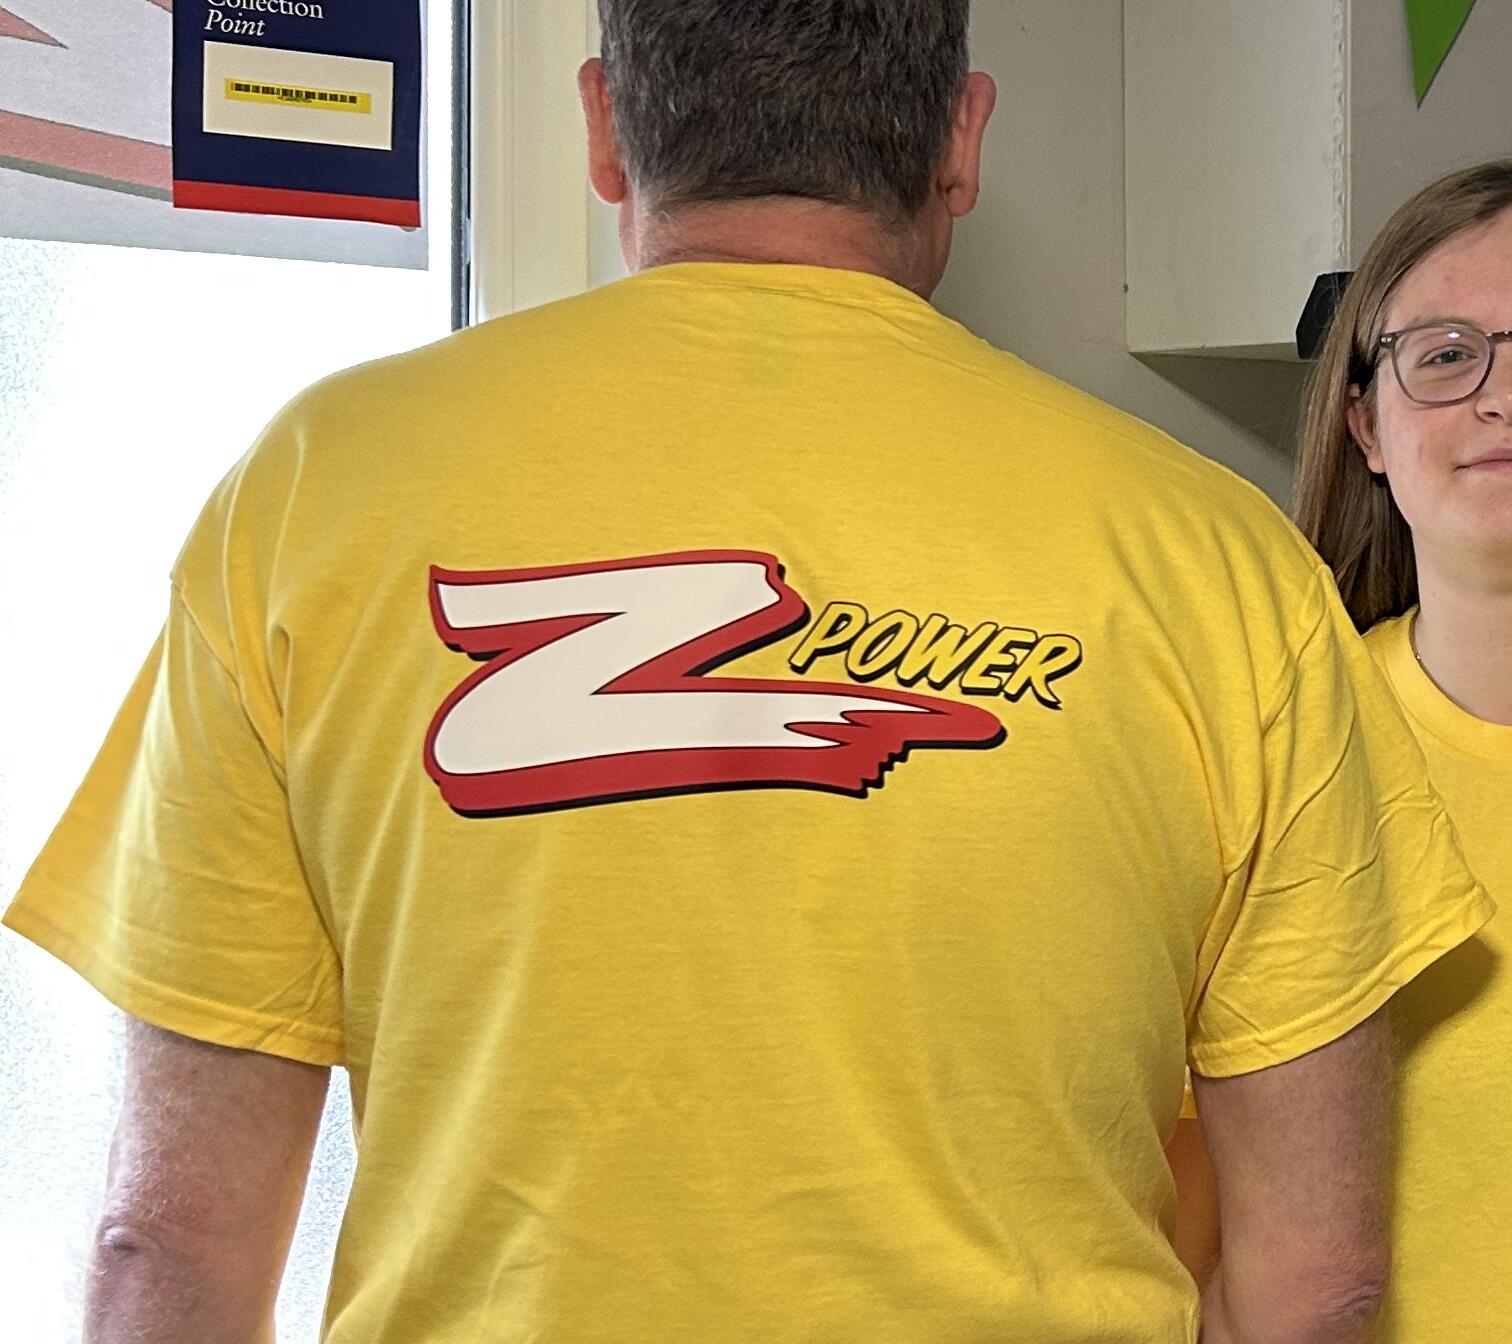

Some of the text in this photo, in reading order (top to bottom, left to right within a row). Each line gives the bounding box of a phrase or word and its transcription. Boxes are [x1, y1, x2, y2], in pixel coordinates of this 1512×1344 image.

[203, 9, 266, 36] Point
[424, 548, 1083, 819] Z POWER
